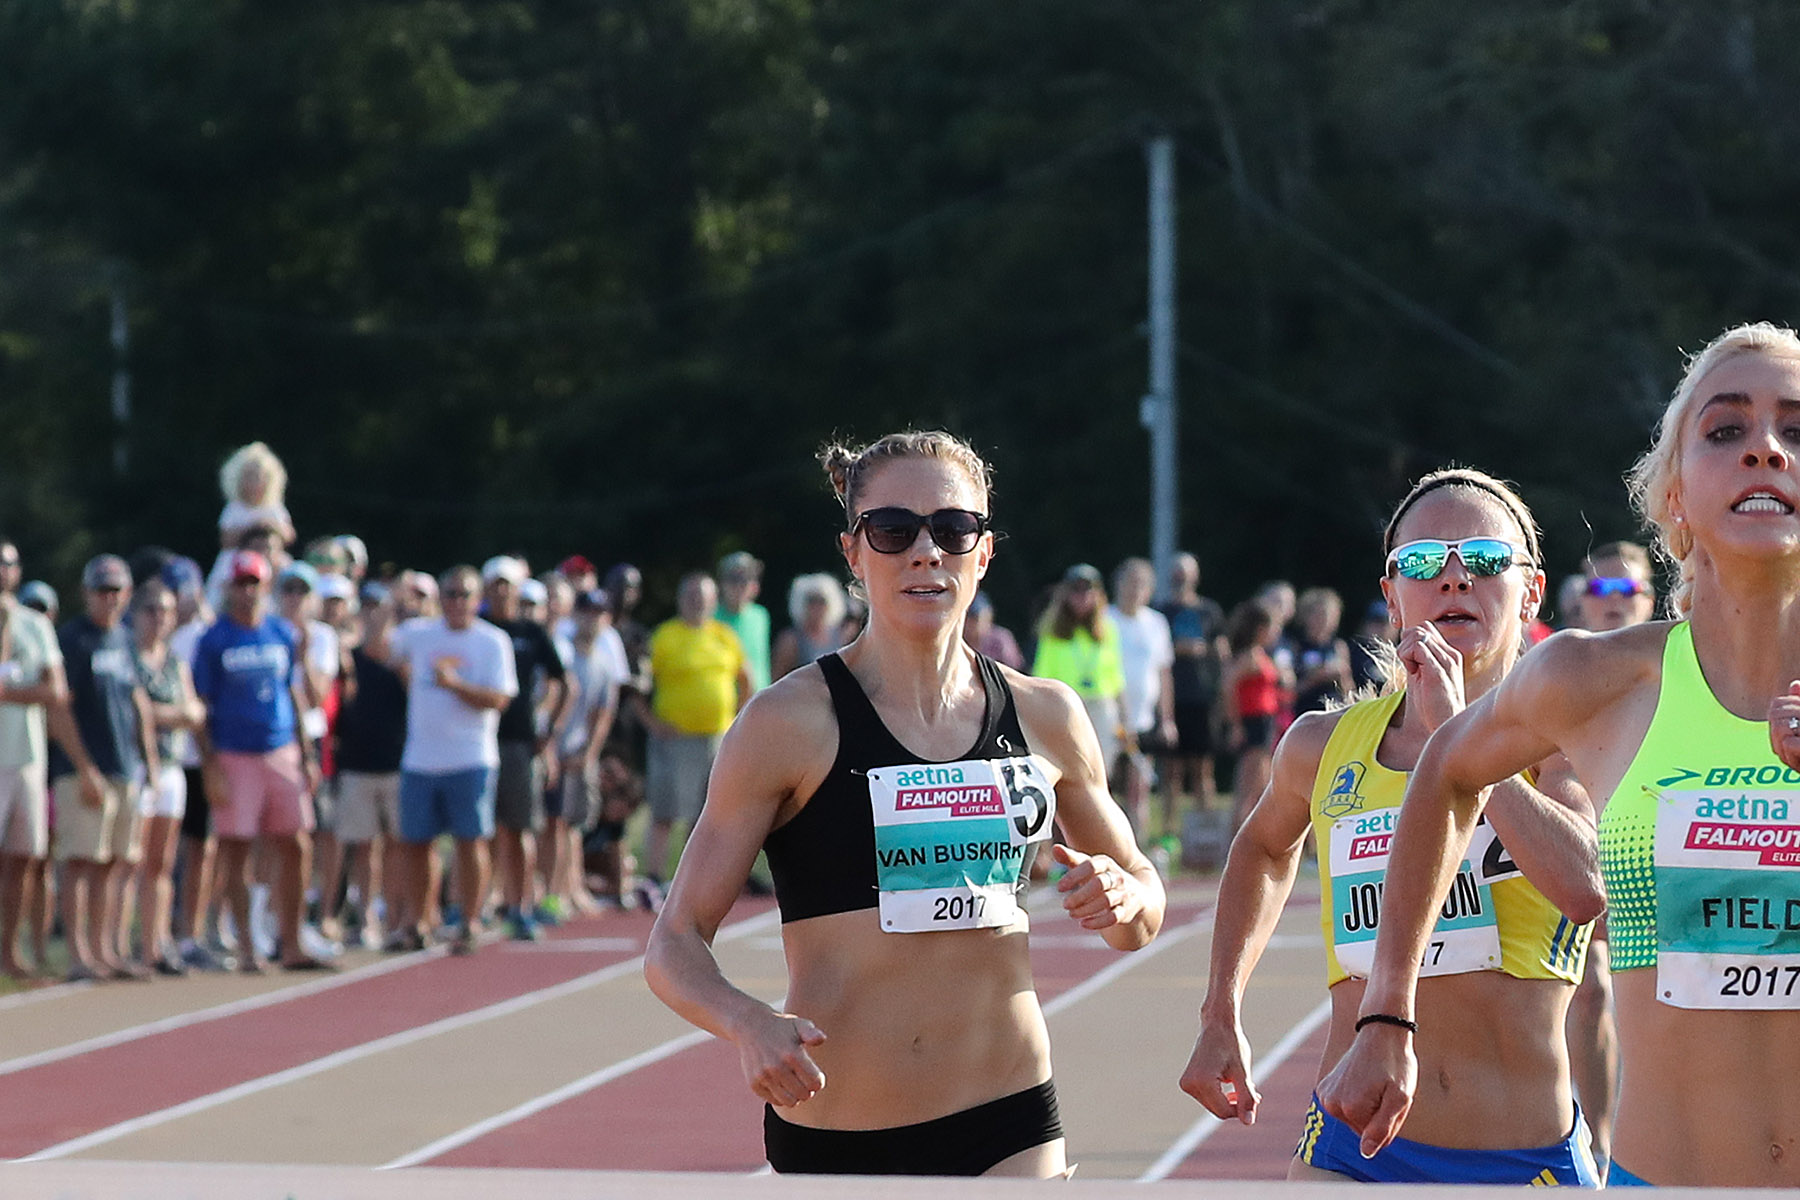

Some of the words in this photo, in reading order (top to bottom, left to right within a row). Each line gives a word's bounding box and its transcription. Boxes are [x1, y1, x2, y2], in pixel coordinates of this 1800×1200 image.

[897, 767, 964, 787] aetna
[901, 788, 992, 807] FALMOUTH
[959, 805, 981, 814] ELITE
[982, 804, 1000, 813] MILE
[1001, 764, 1048, 838] 5
[1696, 794, 1788, 820] aetna
[1355, 811, 1399, 834] aet
[878, 846, 926, 867] VAN
[935, 841, 1022, 864] BUSKIRK
[933, 895, 986, 921] 2017
[1344, 871, 1482, 932] JOON
